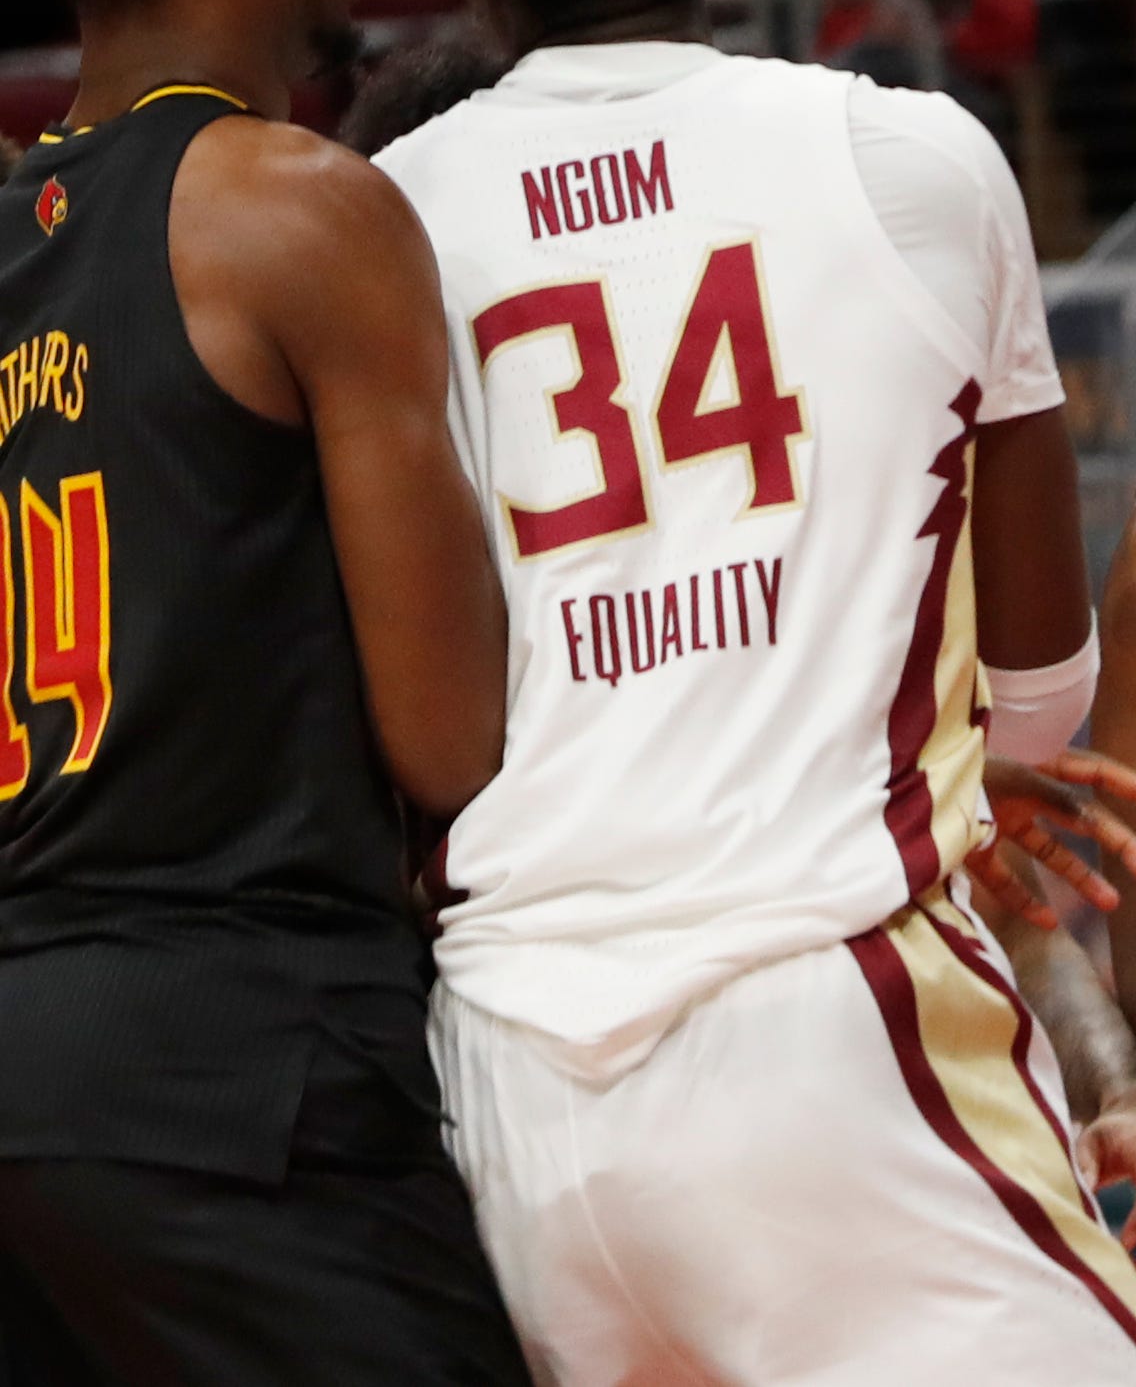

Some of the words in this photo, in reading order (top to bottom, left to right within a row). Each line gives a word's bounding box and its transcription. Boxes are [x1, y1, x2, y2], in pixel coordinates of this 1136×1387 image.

[520, 139, 675, 240] NGOM
[467, 233, 813, 564] 34
[0, 471, 112, 801] 4
[560, 557, 783, 687] EQUALITY
